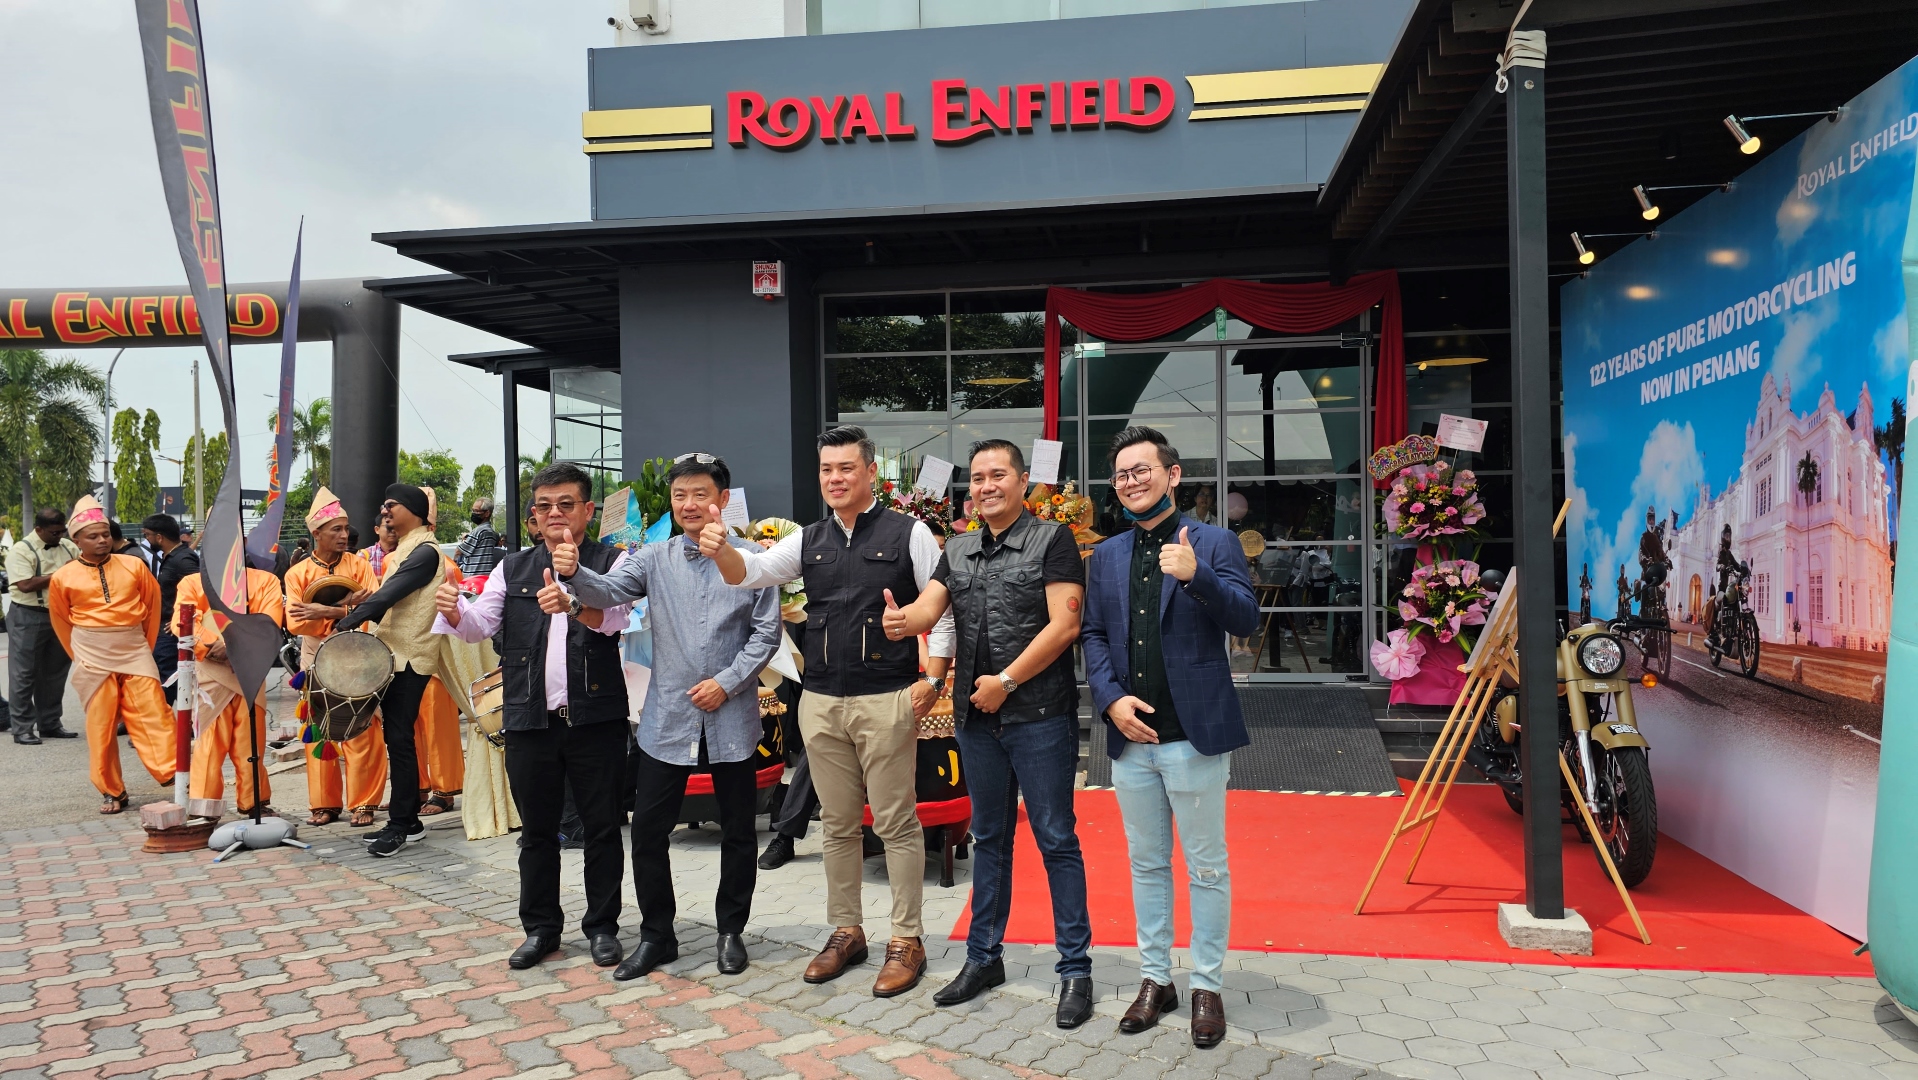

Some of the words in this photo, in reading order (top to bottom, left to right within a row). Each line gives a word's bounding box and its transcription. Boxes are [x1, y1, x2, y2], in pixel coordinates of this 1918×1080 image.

[727, 90, 916, 149] ROYAL
[932, 76, 1177, 145] ENFIELD
[1798, 156, 1845, 199] ROYAL
[1850, 113, 1918, 173] ENFIELD
[1590, 361, 1607, 387] 122
[1608, 344, 1647, 380] YEARS
[1648, 336, 1665, 364] OF
[1667, 318, 1706, 357] PURE
[1708, 251, 1856, 341] MOTORCYCLING
[1641, 372, 1673, 405] NOW
[1675, 366, 1690, 394] IN
[1692, 340, 1760, 389] PENANG
